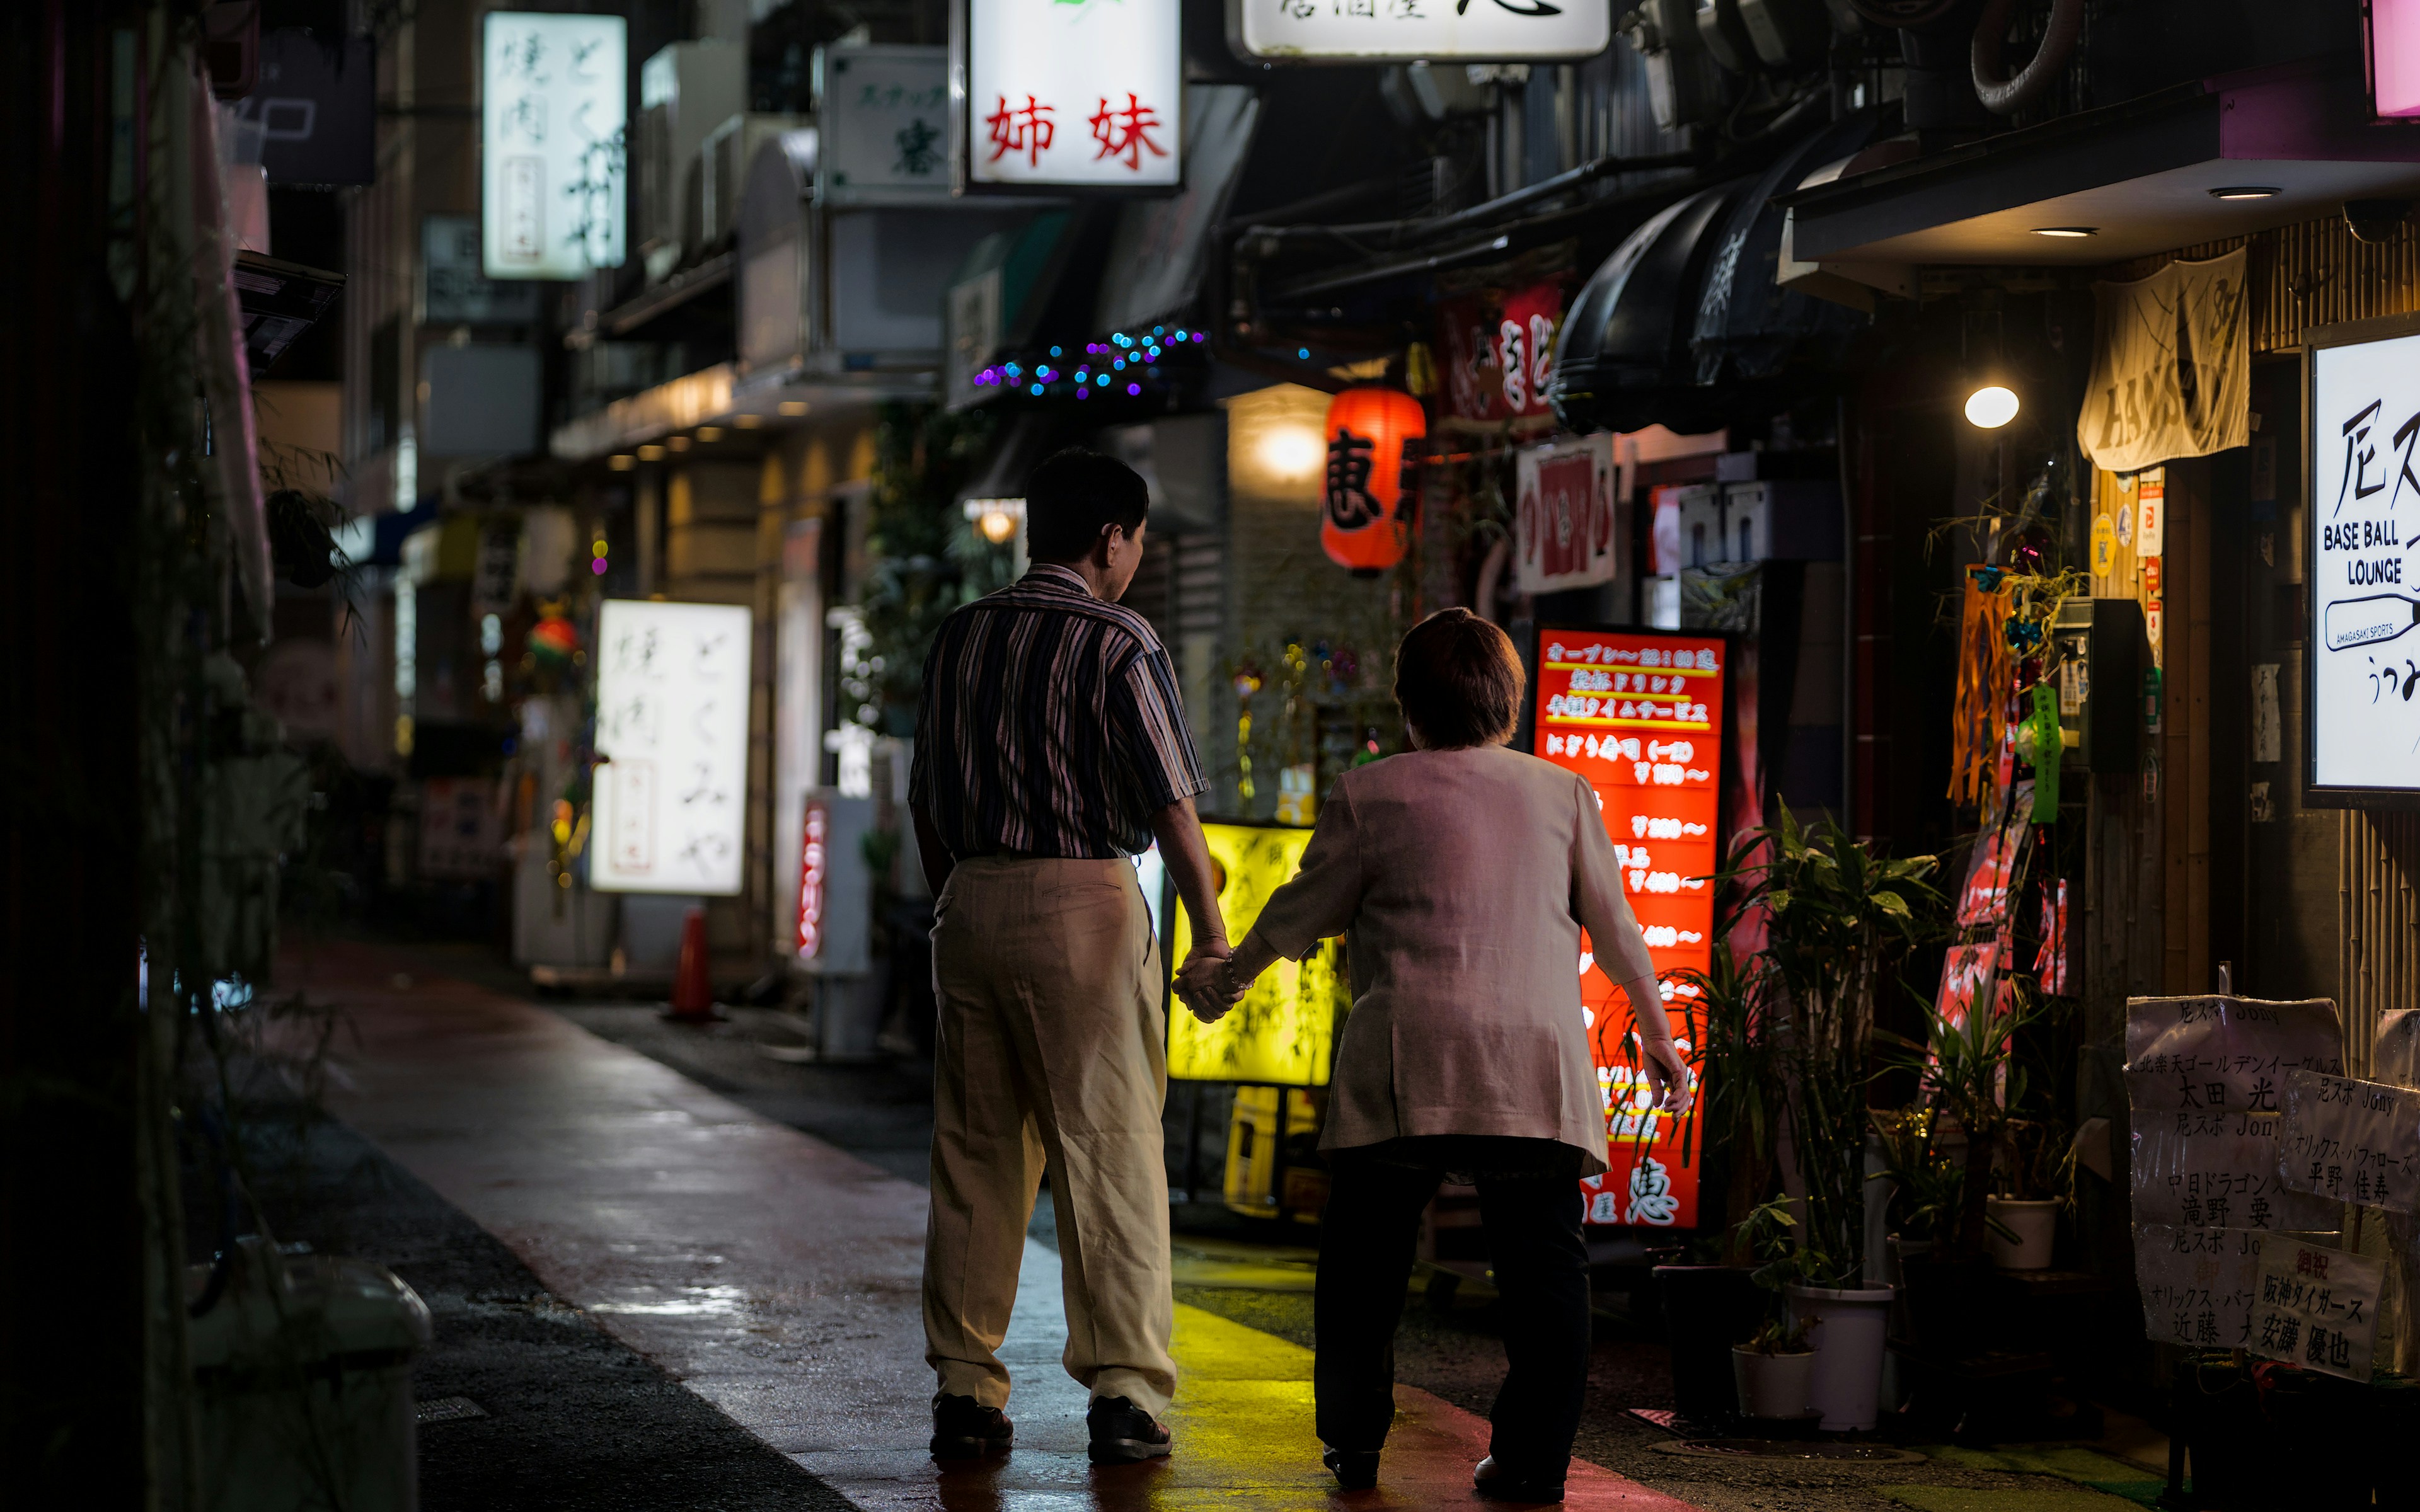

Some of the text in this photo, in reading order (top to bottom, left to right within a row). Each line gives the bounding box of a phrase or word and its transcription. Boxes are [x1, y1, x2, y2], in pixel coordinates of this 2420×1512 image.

[985, 94, 1170, 171] 姉妹
[1328, 429, 1380, 528] 恵
[2324, 520, 2399, 551] BASE BALL
[2348, 558, 2402, 585] LOUNGE
[2336, 622, 2394, 645] AMAGASAKI SPORTS
[2235, 1002, 2279, 1026] Jony
[2179, 1075, 2278, 1111] 太田 光
[2317, 1077, 2395, 1117] 尼スポ Jony
[2174, 1112, 2226, 1138] 尼スポ
[2308, 1161, 2390, 1207] 平野 佳寿
[2181, 1195, 2273, 1230] 滝野 要
[2171, 1228, 2225, 1255] 尼スポ
[2297, 1247, 2329, 1280] 御祝
[2263, 1274, 2363, 1324] 阪神タイガース
[2172, 1310, 2221, 1345] 近藤
